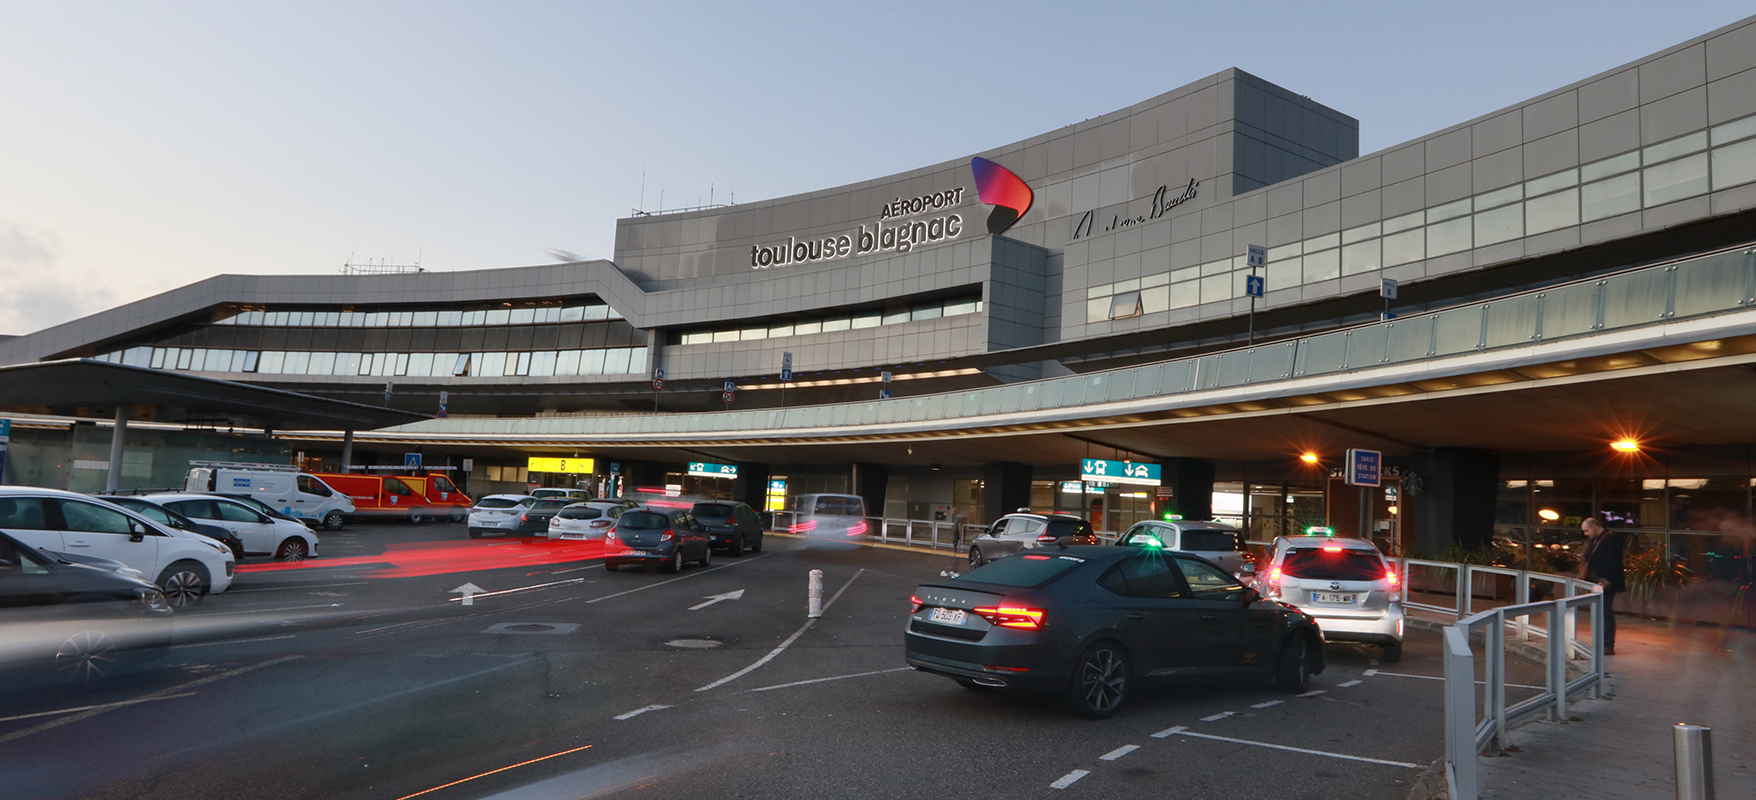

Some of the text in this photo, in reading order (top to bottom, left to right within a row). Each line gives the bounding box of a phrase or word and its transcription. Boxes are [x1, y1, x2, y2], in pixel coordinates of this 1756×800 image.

[880, 187, 964, 220] AÉROPORT
[750, 214, 963, 269] toulouse blagnac
[1250, 255, 1263, 265] A B
[561, 460, 566, 470] B
